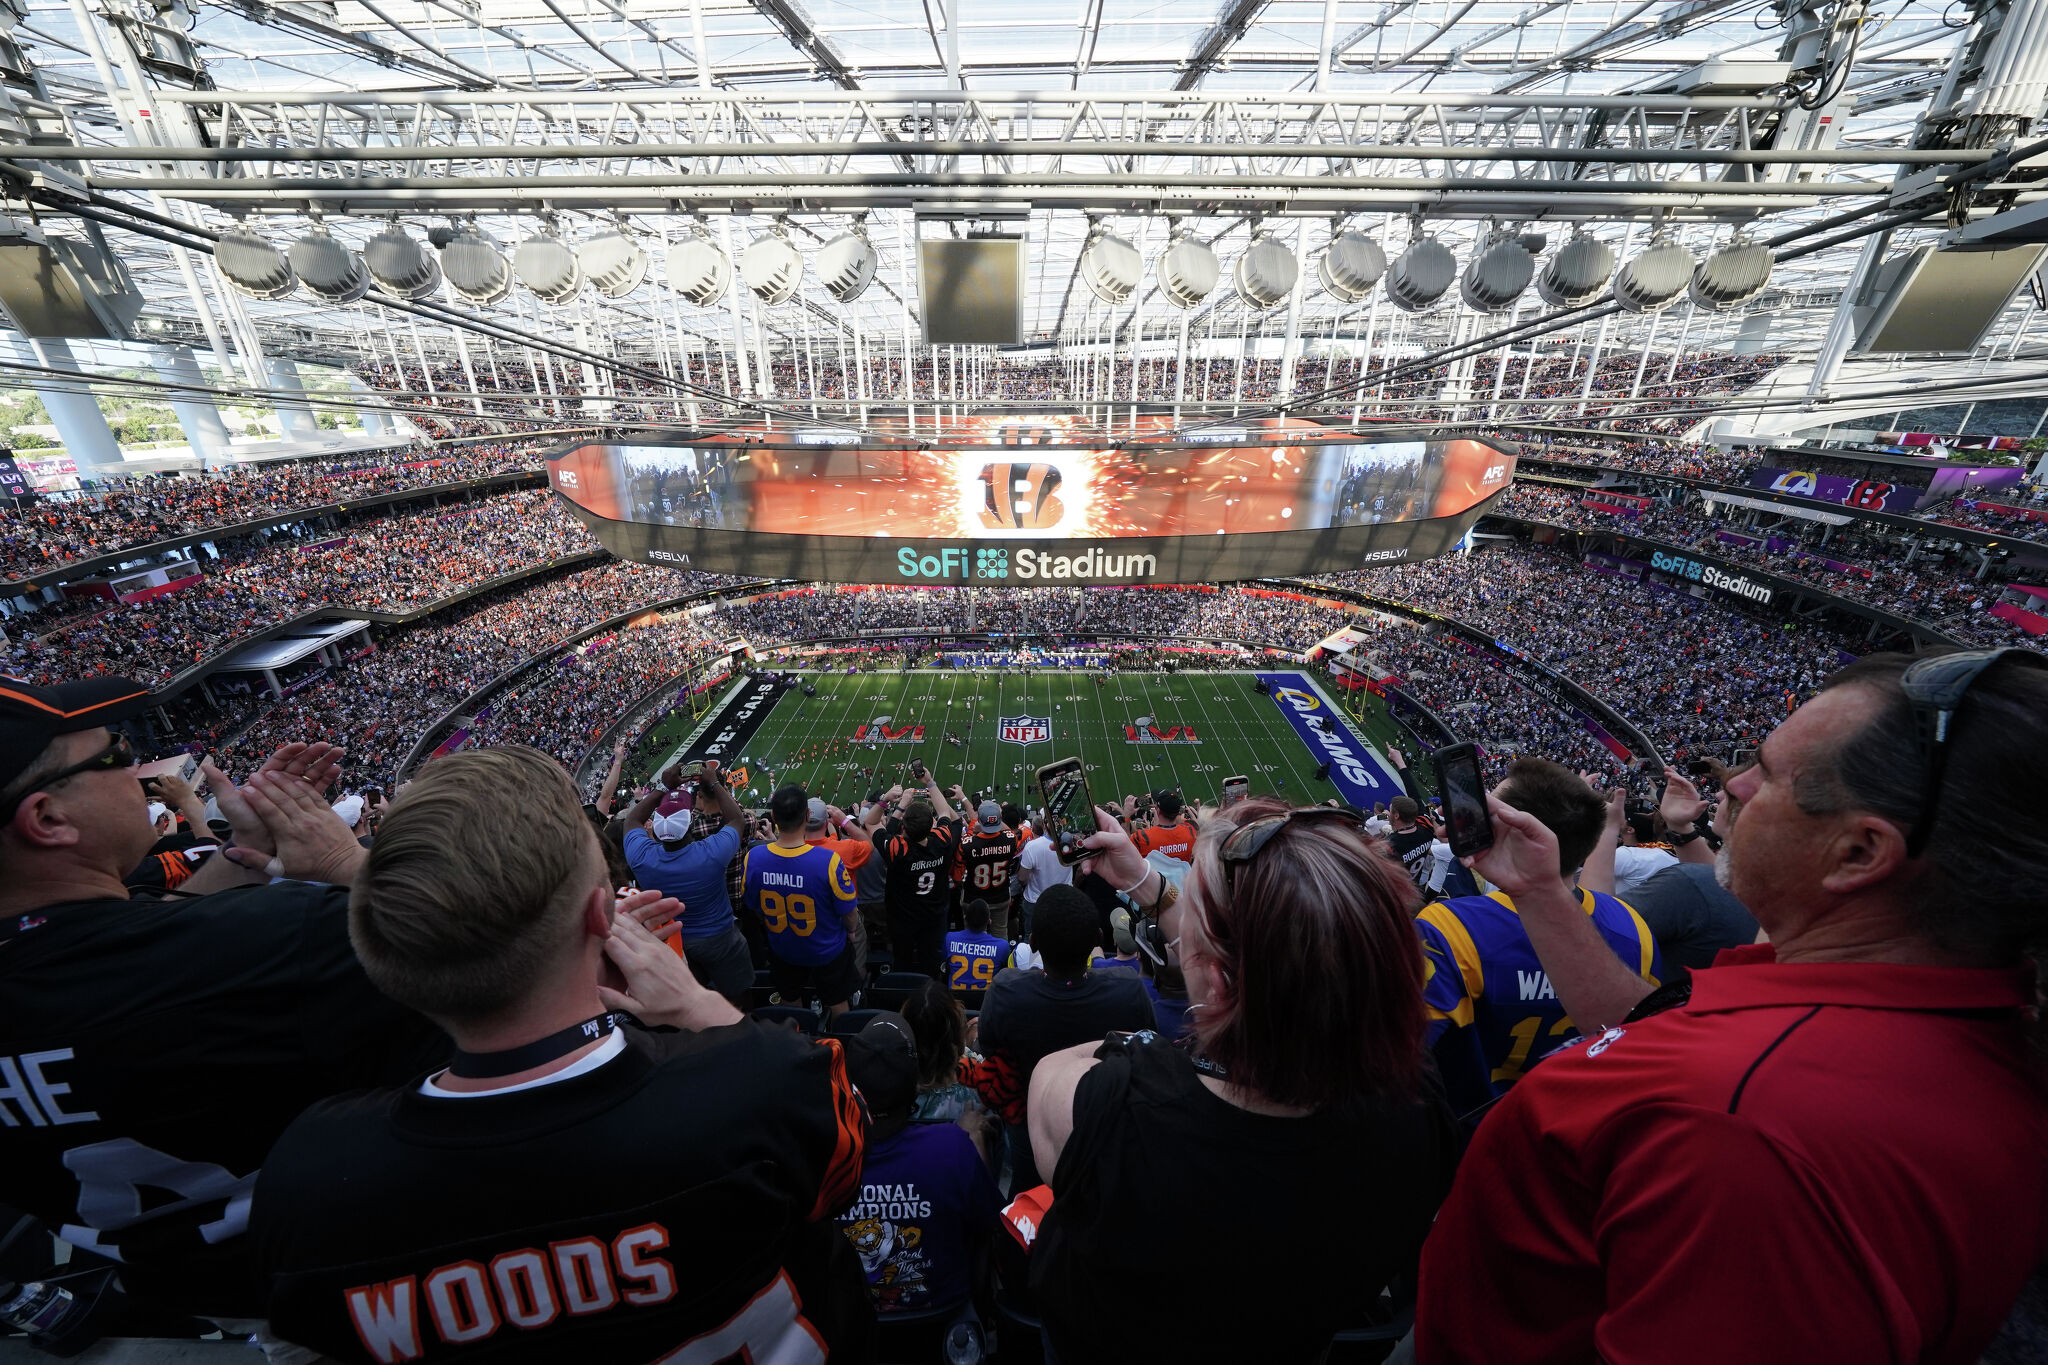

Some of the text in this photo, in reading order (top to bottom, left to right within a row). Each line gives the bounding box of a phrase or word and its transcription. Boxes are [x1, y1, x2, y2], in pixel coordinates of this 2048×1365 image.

[558, 470, 577, 484] AFC
[1483, 465, 1505, 480] AFC
[1770, 471, 1817, 496] LA
[649, 550, 690, 563] #SBLVI
[897, 546, 1156, 579] SoFi Stadium
[1364, 548, 1409, 562] #SBLVI
[1650, 551, 1772, 604] SoFi Stadium
[705, 684, 774, 755] BEGALS
[1005, 727, 1046, 742] NFL
[1132, 763, 1155, 772] 30
[1191, 763, 1214, 772] 20
[1252, 763, 1275, 772] 10
[971, 845, 1011, 858] C. JOHNSON
[1159, 843, 1188, 855] BURROW
[1402, 841, 1432, 863] BURROW
[910, 856, 944, 871] BURROW
[762, 871, 804, 889] DONALD
[916, 871, 936, 895] 9
[974, 860, 1008, 890] 85
[760, 889, 817, 937] 99
[950, 941, 997, 957] DICKERSON
[950, 954, 995, 991] 29
[1517, 970, 1558, 1001] WA
[344, 1221, 679, 1365] WOODS
